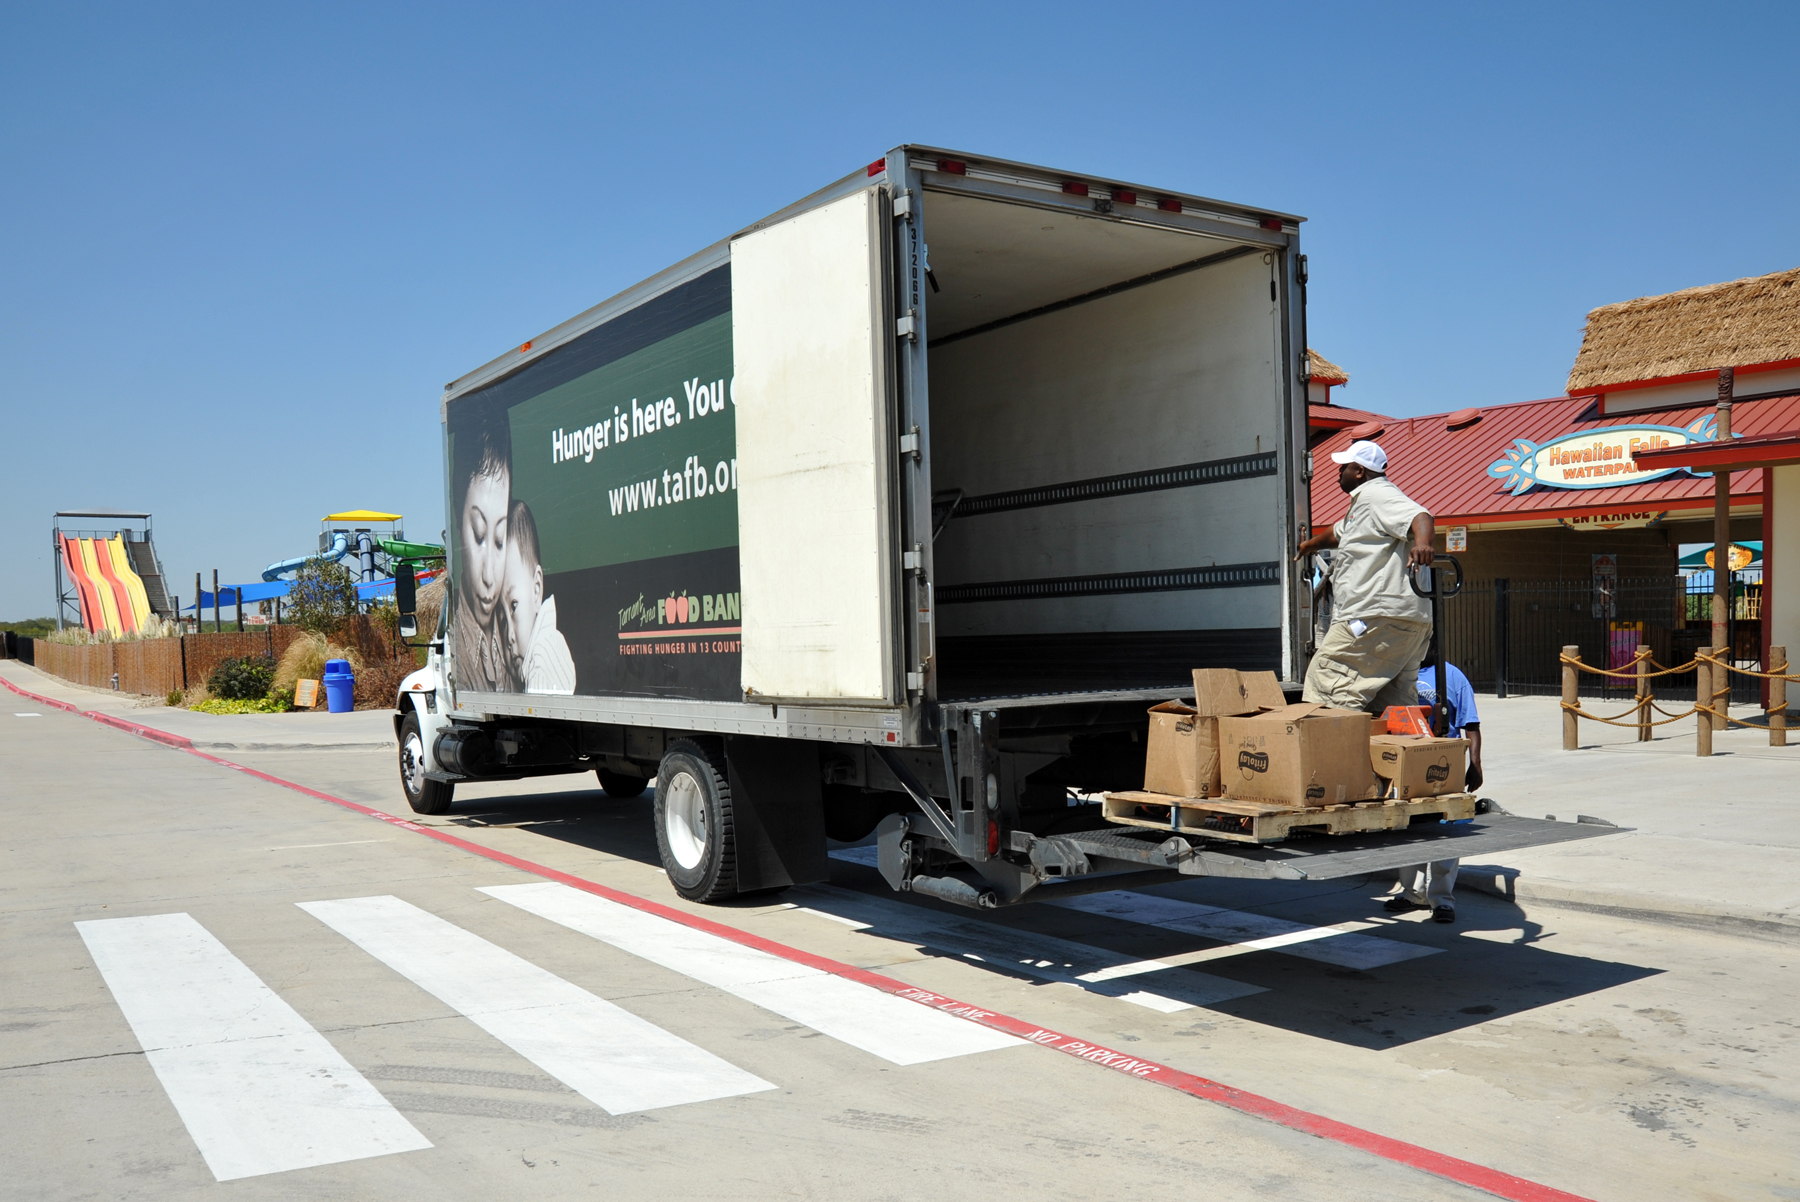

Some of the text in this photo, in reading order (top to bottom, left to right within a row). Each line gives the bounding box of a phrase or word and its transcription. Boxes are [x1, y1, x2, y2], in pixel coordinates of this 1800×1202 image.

[552, 418, 610, 463] Hunger
[614, 405, 628, 443] is
[632, 398, 681, 437] here.
[683, 377, 724, 419] You
[1549, 442, 1623, 466] Hawaiian
[618, 592, 644, 630] Tarrant
[703, 592, 741, 621] BAN
[619, 643, 652, 655] FIGHTING
[655, 641, 686, 654] HUNGER
[688, 641, 697, 653] IN
[700, 641, 709, 653] 13
[895, 988, 1160, 1076] FIRE LANE NO PARKING
